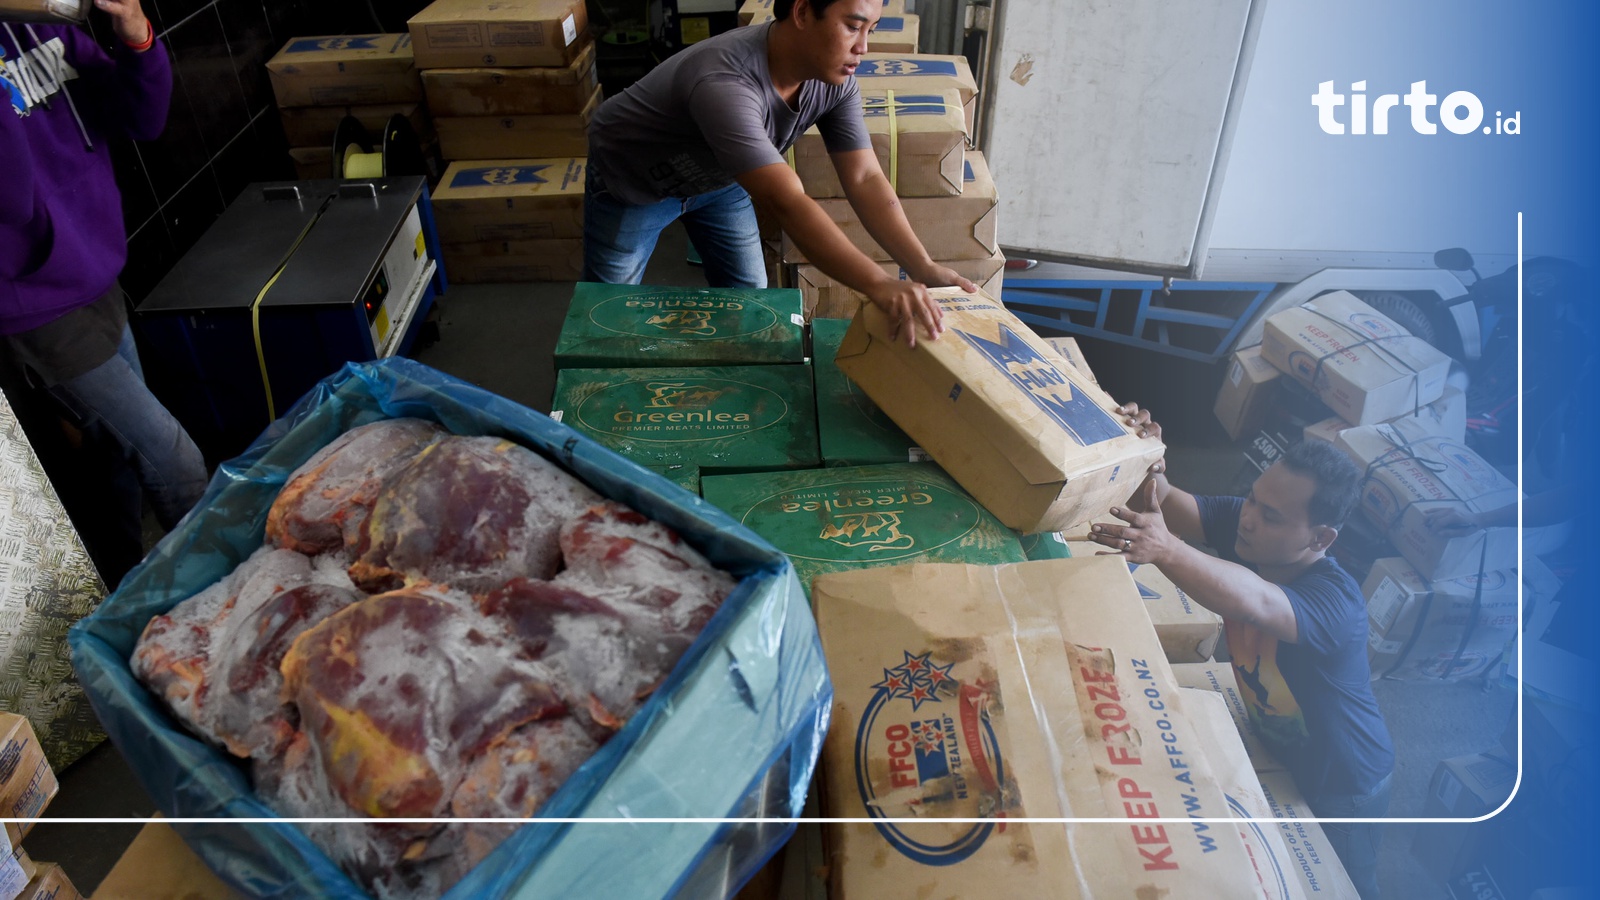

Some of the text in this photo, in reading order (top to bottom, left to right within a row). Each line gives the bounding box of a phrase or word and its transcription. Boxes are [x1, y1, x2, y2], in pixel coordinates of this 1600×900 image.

[625, 300, 744, 311] Greenlea
[1305, 324, 1360, 363] KEEP FROZEN
[1012, 367, 1066, 391] AMH
[611, 424, 661, 432] PREMIER
[613, 409, 750, 423] Greenlea
[1407, 467, 1447, 500] FROZEN
[782, 492, 933, 513] Greenlea
[885, 723, 919, 792] FFCO
[1080, 647, 1180, 872] KEEP FROZE
[1131, 658, 1218, 854] WWW.AFFCO.CO.NZ
[1285, 832, 1297, 845] OF
[1303, 840, 1322, 865] KEEP
[1292, 846, 1321, 892] PRODUCT
